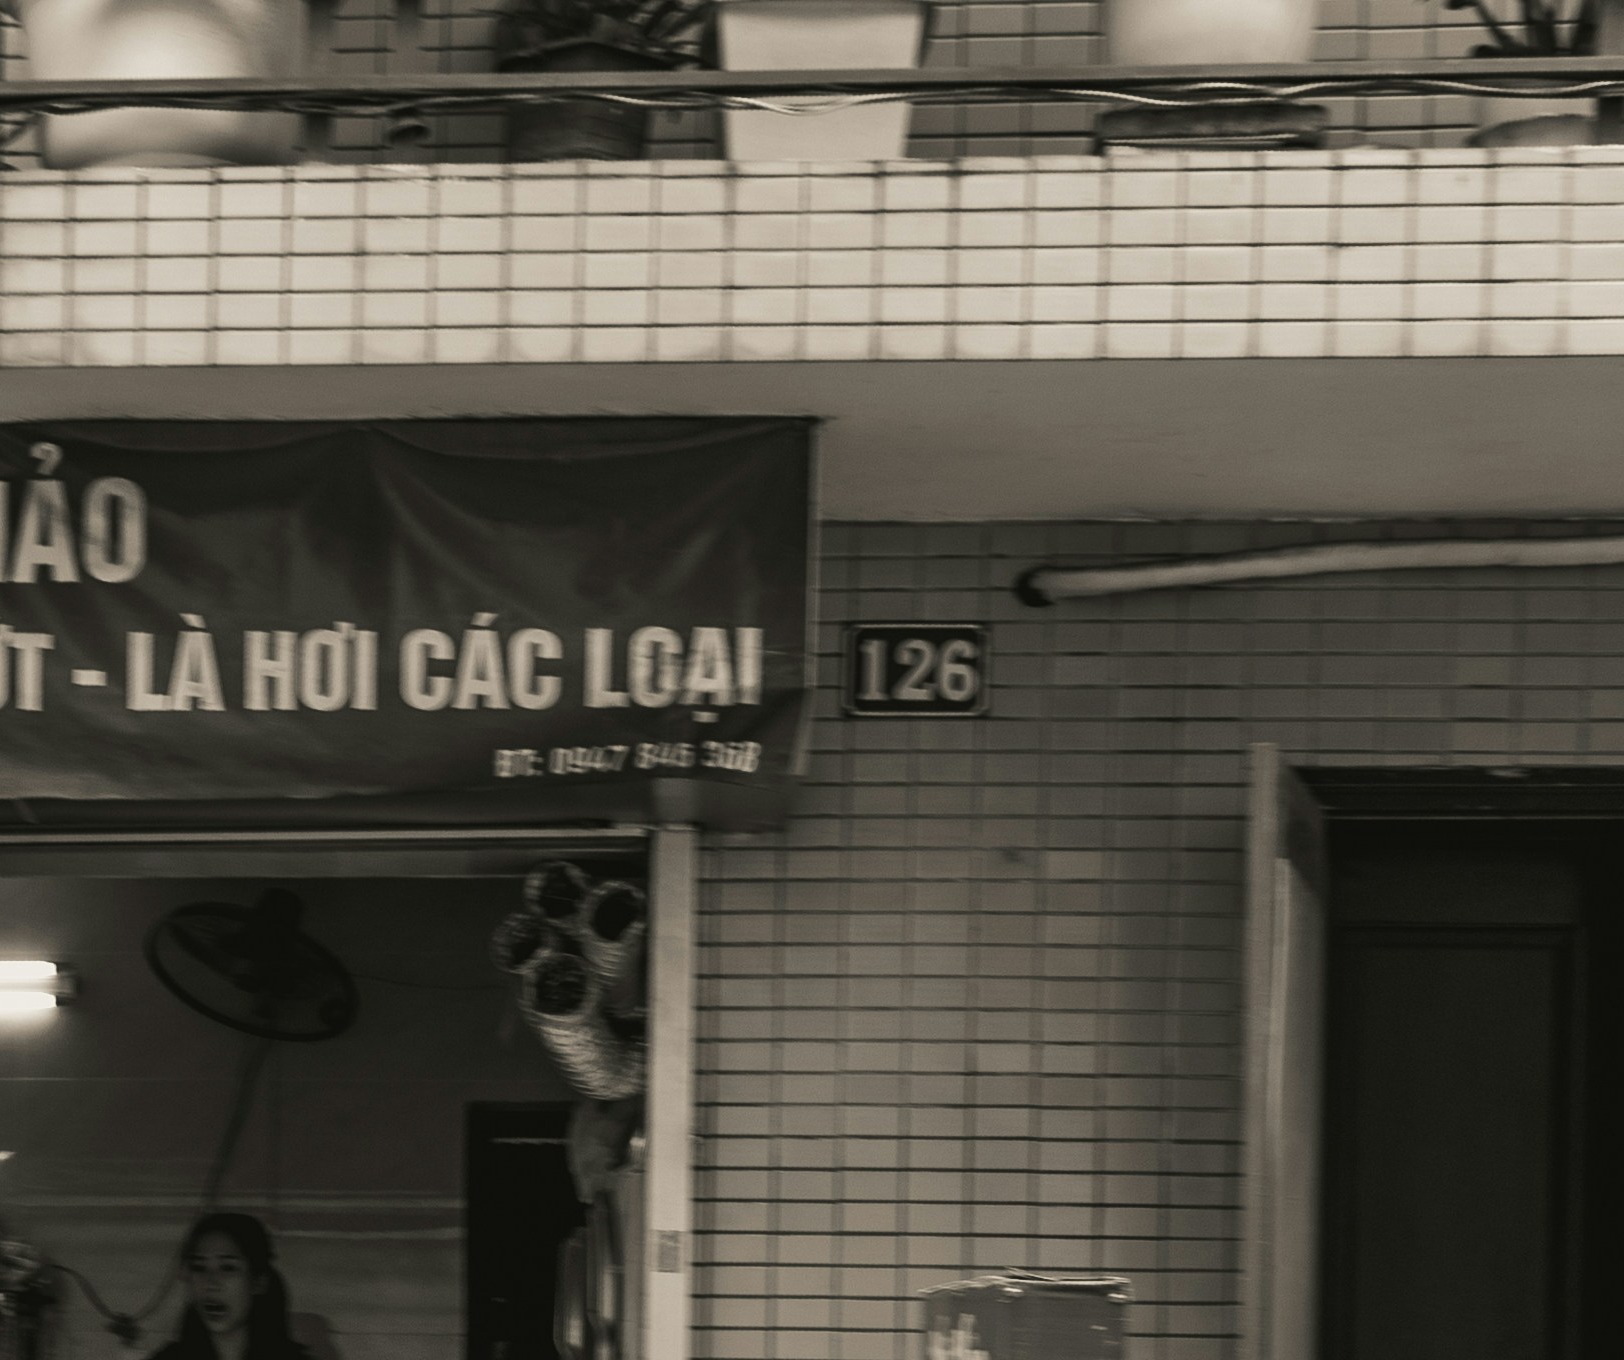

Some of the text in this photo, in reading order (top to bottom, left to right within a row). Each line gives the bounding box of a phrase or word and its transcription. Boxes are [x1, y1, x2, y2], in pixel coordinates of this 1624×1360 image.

[72, 668, 107, 686] -
[124, 613, 226, 712] LÀ
[244, 623, 378, 712] HƠI
[399, 612, 563, 712] CÁC
[584, 626, 766, 723] LOẠI
[858, 639, 979, 701] 126
[549, 744, 630, 775] 0947
